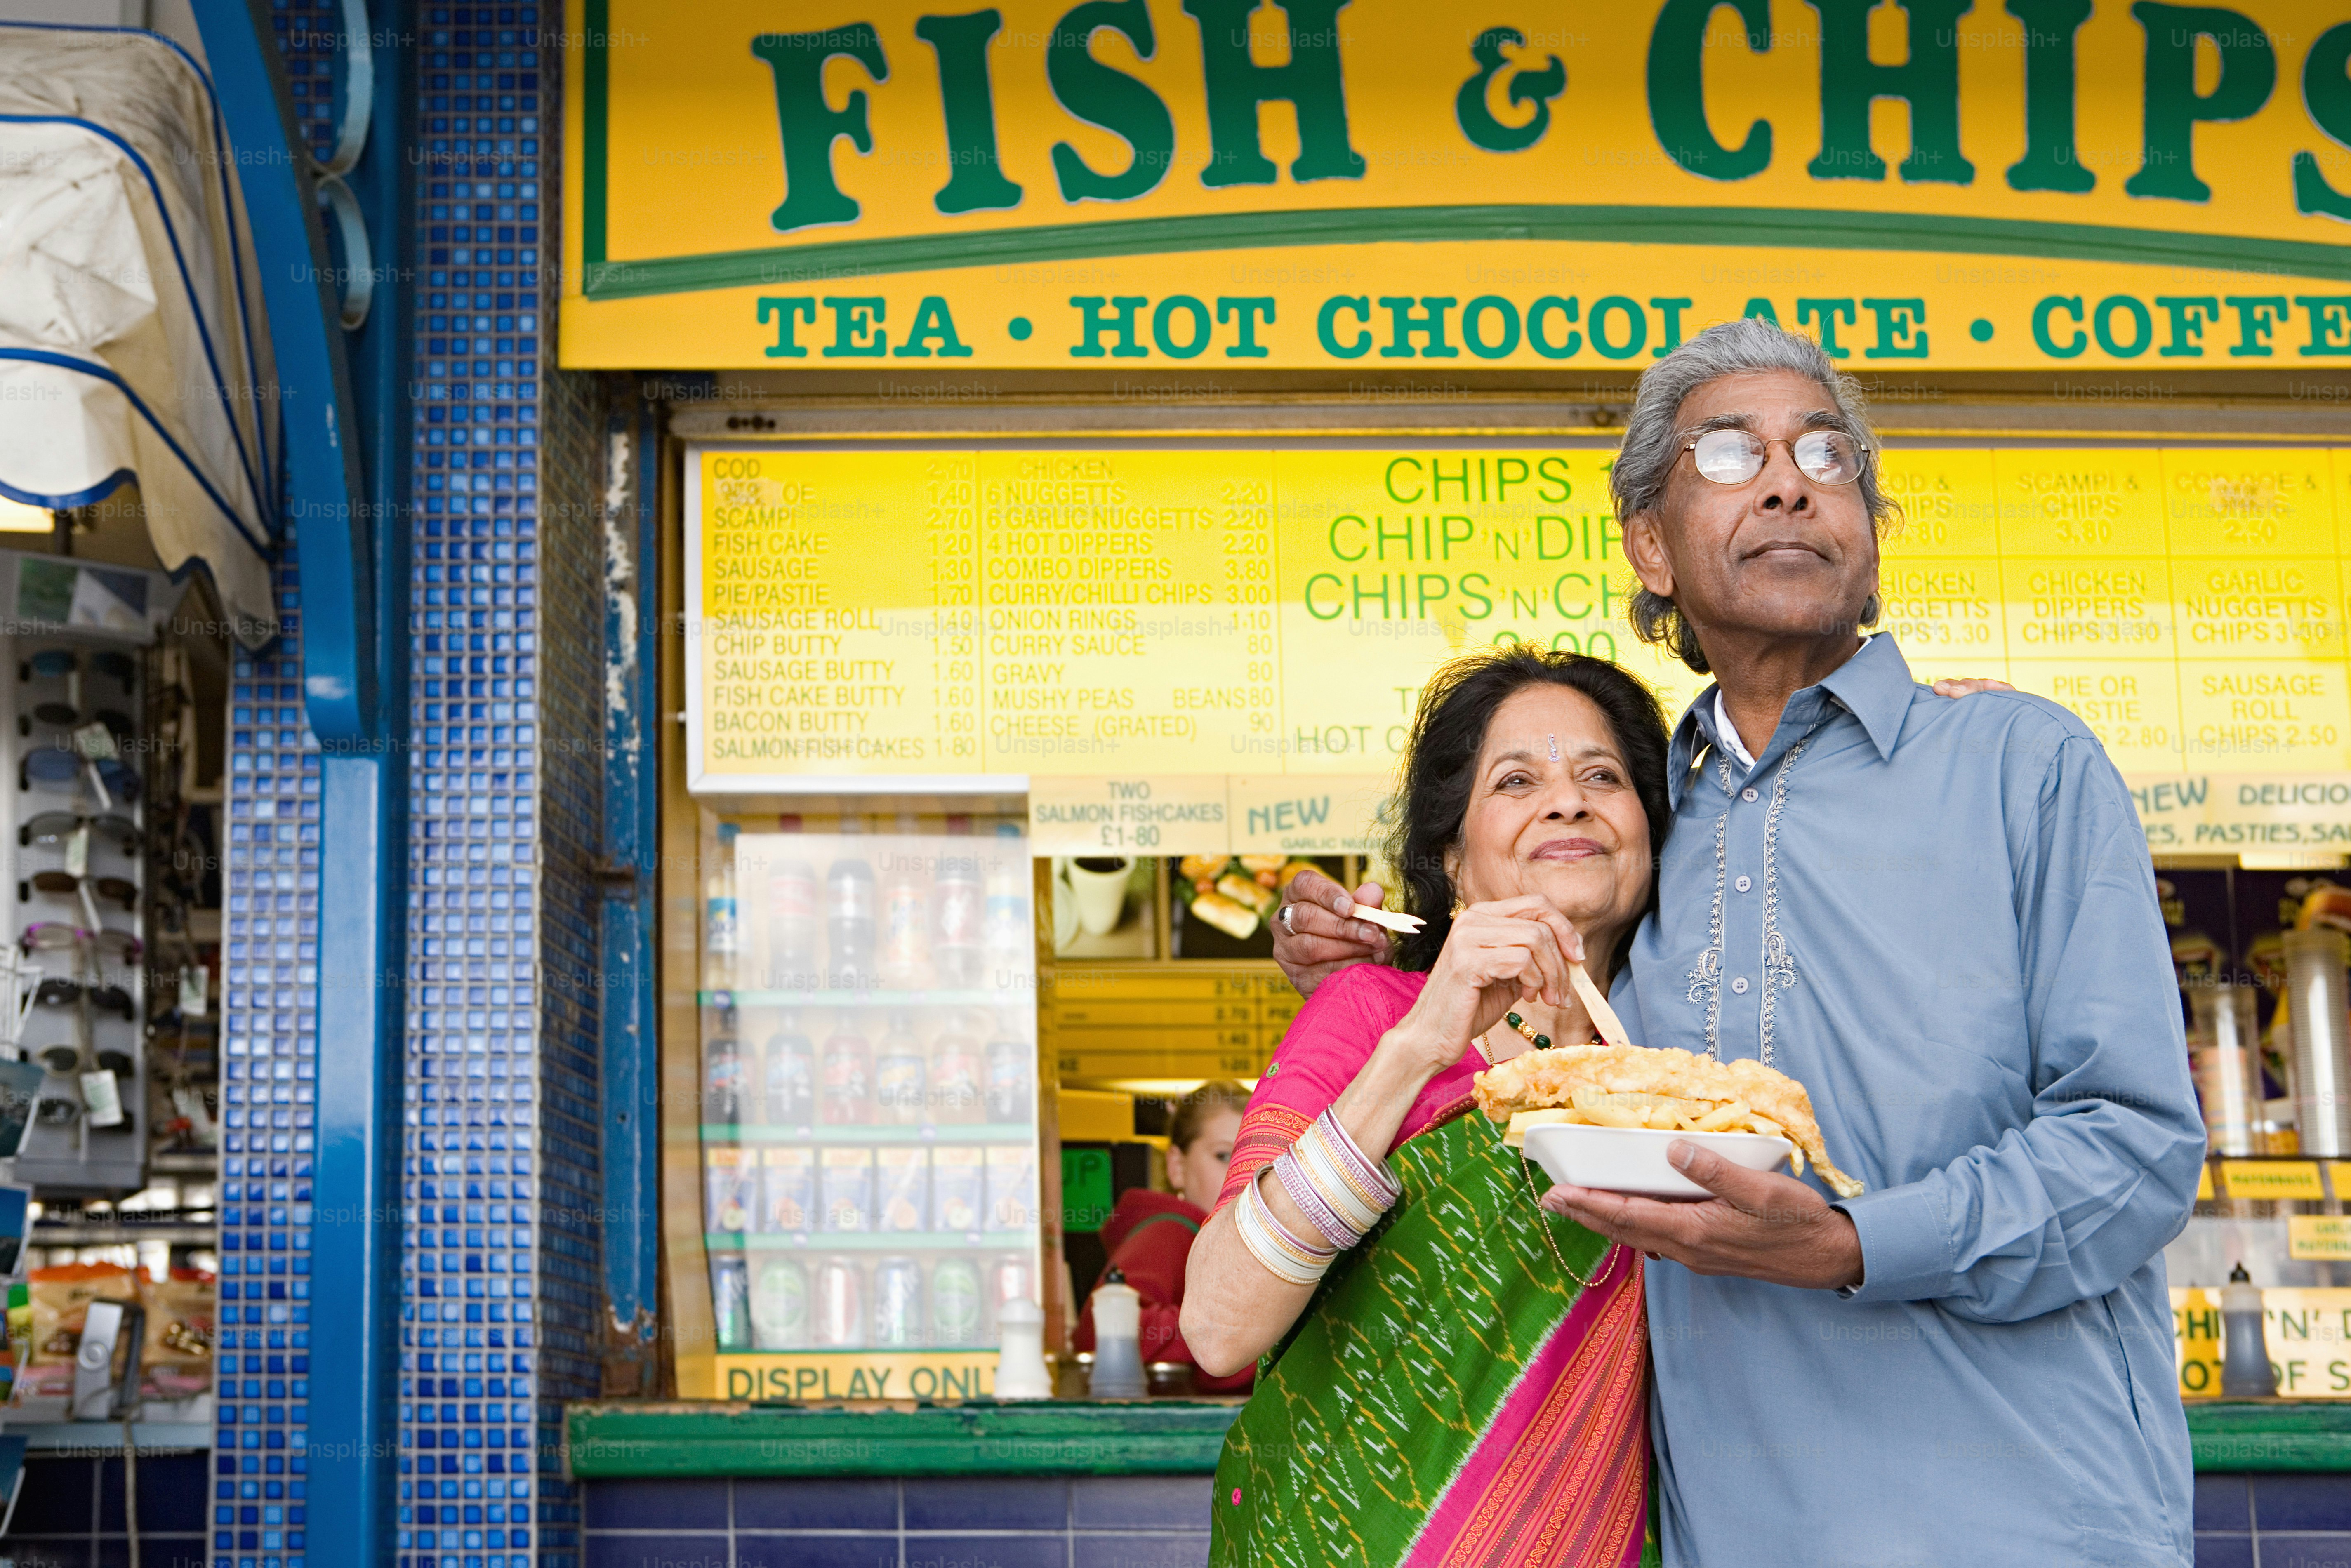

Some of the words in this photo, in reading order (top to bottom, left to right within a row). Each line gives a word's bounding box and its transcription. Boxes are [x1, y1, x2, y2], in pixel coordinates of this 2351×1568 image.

[750, 0, 1366, 232] FISH
[1455, 26, 1567, 154] &
[756, 295, 973, 359] TEA
[1069, 295, 1276, 359] HOT
[713, 458, 761, 479] COD
[1017, 458, 1113, 480] CHICKEN
[1385, 457, 1571, 503] CHIPS
[1890, 473, 1925, 492] OD
[2019, 474, 2114, 492] SCAMPI
[987, 483, 1001, 504] 6
[1007, 483, 1126, 504] NUGGETTS
[2043, 497, 2122, 518] CHIPS
[714, 508, 797, 530] SCAMPI
[928, 508, 973, 530] 2.70
[989, 508, 1001, 530] 6
[1007, 508, 1088, 530] GARLIC
[1095, 508, 1213, 530] NUGGETTS
[2056, 520, 2112, 544] 3.80
[714, 533, 760, 555] FISH
[768, 533, 829, 555] CAKE
[989, 533, 1001, 554] 4
[1008, 533, 1054, 554] HOT
[1059, 533, 1153, 554] DIPPERS
[714, 558, 819, 581] SAUSAGE
[928, 558, 973, 581] 1.30
[989, 558, 1072, 580] COMBO
[1079, 558, 1172, 580] DIPPERS
[1226, 558, 1270, 580] 3.80
[1881, 572, 1975, 594] HICKEN
[2029, 572, 2145, 594] CHICKEN
[2207, 570, 2304, 593] GARLIC
[714, 584, 829, 605] PIE/PASTIE
[925, 584, 973, 605] 1.70
[990, 583, 1139, 605] CURRY/CHILLI
[1146, 583, 1212, 605] CHIPS
[1226, 583, 1270, 605] 3.00
[1888, 598, 1989, 618] GGETTS
[2034, 598, 2144, 619] DIPPERS
[2187, 597, 2327, 619] NUGGETTS
[714, 609, 819, 630] SAUSAGE
[825, 609, 879, 630] ROLL
[990, 610, 1060, 630] ONION
[1069, 610, 1137, 630] RINGS
[1939, 623, 1990, 643] 3.30
[2024, 623, 2098, 643] CHIPS
[2192, 622, 2269, 643] CHIPS
[714, 635, 765, 655] CHIP
[774, 635, 842, 655] BUTTY
[932, 635, 973, 655] 1.50
[990, 635, 1065, 655] CURRY
[1072, 635, 1147, 655] SAUCE
[1248, 635, 1272, 655] 80
[714, 661, 818, 681] SAUSAGE
[825, 661, 895, 681] BUTTY
[932, 661, 974, 681] 1.60
[992, 663, 1065, 683] GRAVY
[1248, 663, 1272, 683] 80
[714, 686, 761, 706] FISH
[770, 686, 829, 706] CAKE
[836, 686, 905, 706] BUTTY
[933, 686, 974, 706] 1.60
[2054, 676, 2092, 696] PIE
[2100, 676, 2138, 696] OR
[2203, 676, 2324, 696] SAUSAGE
[993, 688, 1070, 709] MUSHY
[1078, 688, 1133, 709] PEAS
[1173, 688, 1246, 709] BEANS
[2069, 700, 2142, 721] ASTIE
[2232, 700, 2299, 720] ROLL
[714, 712, 791, 732] BACON
[800, 712, 869, 732] BUTTY
[934, 712, 974, 732] 1.60
[991, 716, 1079, 736] CHEESE
[1095, 716, 1197, 741] (GRATED)
[1249, 712, 1274, 732] 90
[1297, 726, 1372, 754] HOT
[2116, 725, 2168, 747] 2.80
[2199, 725, 2278, 745] CHIPS
[2285, 725, 2337, 745] 2.50
[714, 737, 797, 758] SALMON
[1108, 782, 1150, 800] TWO
[1036, 803, 1114, 823] SALMON
[1119, 803, 1223, 822] FISHCAKES
[1248, 796, 1330, 835] NEW
[728, 1367, 890, 1401] DISPLAY
[909, 1366, 1000, 1400] ONL
